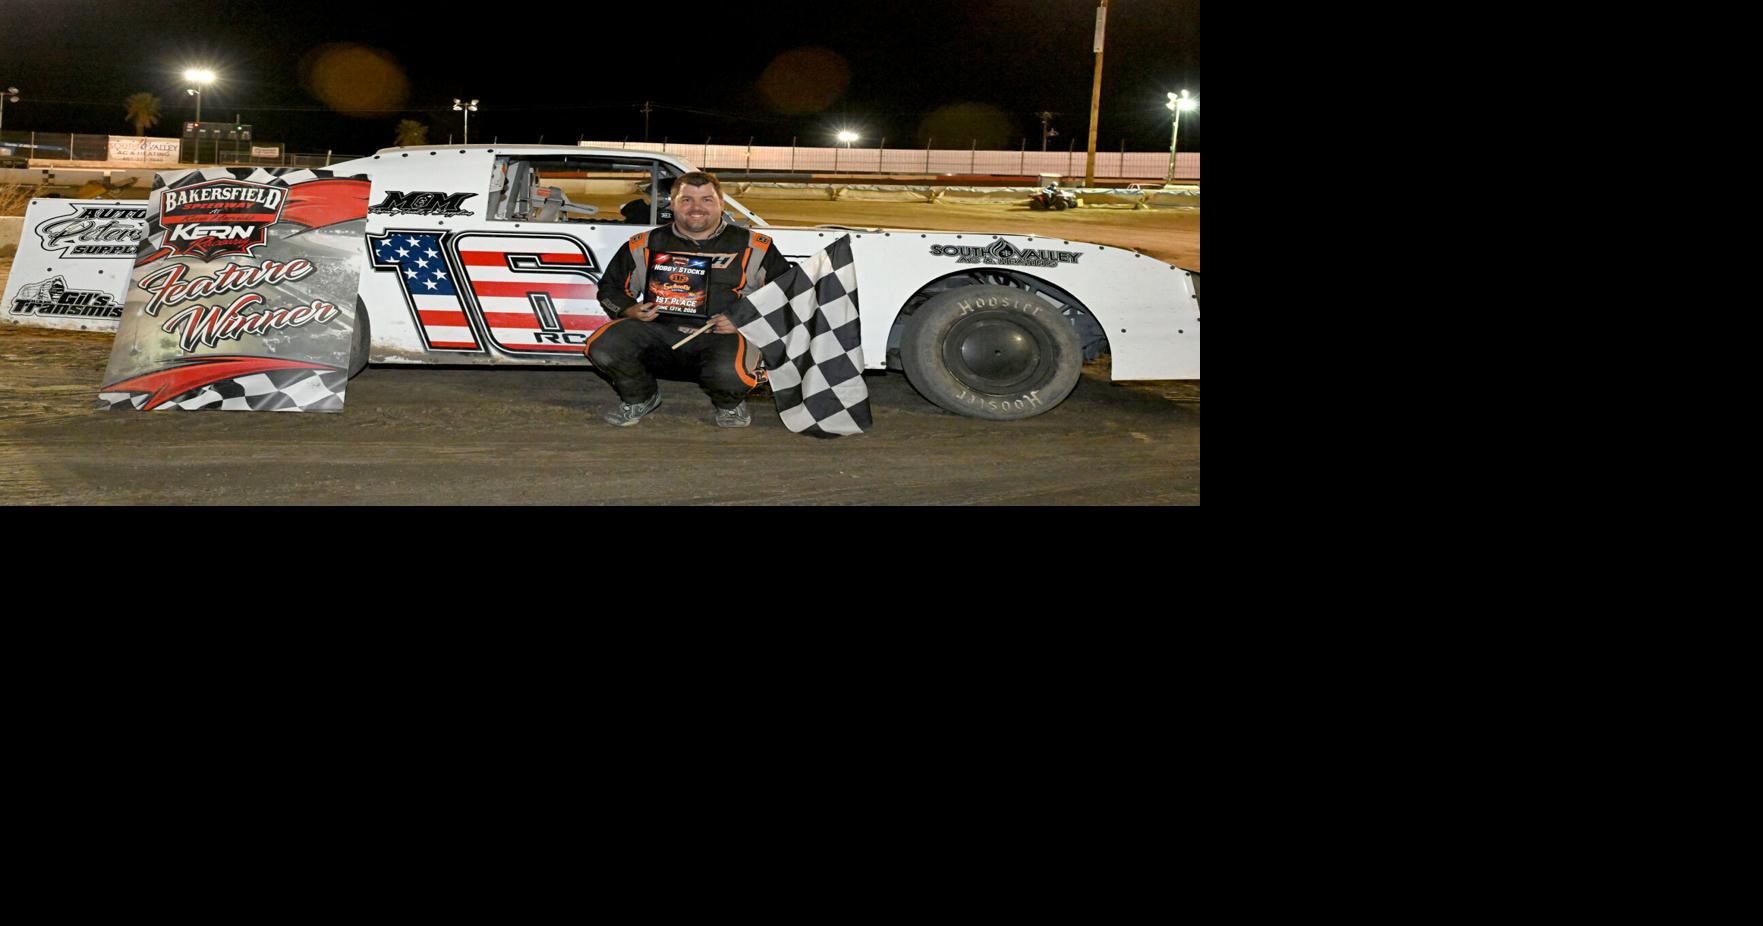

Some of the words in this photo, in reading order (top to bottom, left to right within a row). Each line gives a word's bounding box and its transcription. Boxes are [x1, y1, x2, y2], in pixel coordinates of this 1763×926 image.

[148, 143, 178, 152] VALLEY
[164, 187, 281, 213] BAKERSFIELD
[181, 202, 256, 210] SPEEDWAY
[79, 208, 148, 219] AUTO
[169, 223, 255, 241] KERN
[929, 244, 991, 258] SOUTH
[1012, 248, 1085, 264] VALLEY
[654, 264, 678, 272] HOBBY
[678, 267, 706, 275] STOCKS
[138, 258, 317, 317] Feature
[366, 229, 602, 357] 16
[58, 291, 112, 306] Gil's
[655, 295, 669, 304] 1ST
[670, 297, 698, 307] PLACE
[957, 296, 1044, 317] Hoosier
[11, 299, 123, 317] Transmis
[162, 292, 341, 353] Winner
[534, 332, 588, 344] RC
[955, 389, 1042, 410] Hoosier
